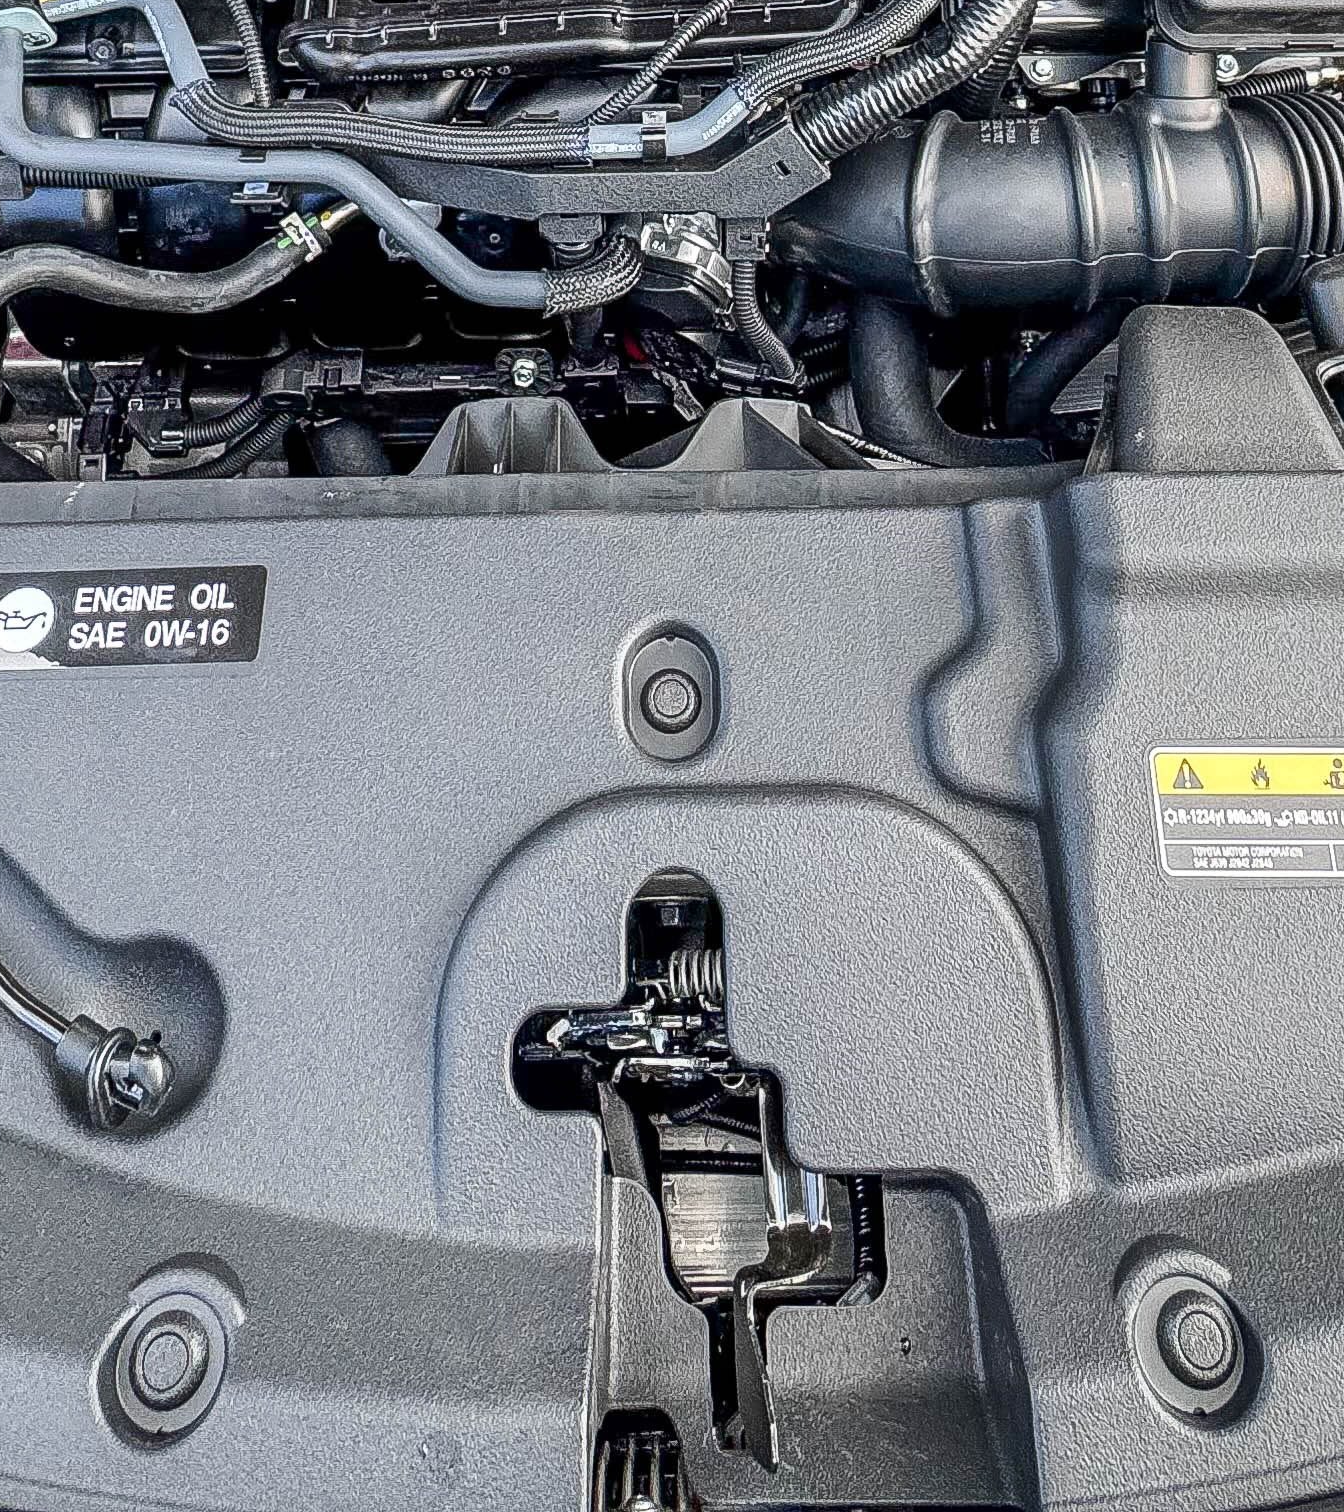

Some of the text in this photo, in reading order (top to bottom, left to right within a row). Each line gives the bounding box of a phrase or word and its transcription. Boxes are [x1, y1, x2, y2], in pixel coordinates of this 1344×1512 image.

[73, 583, 235, 614] ENGINE OIL
[67, 619, 231, 650] SAE 0W-16
